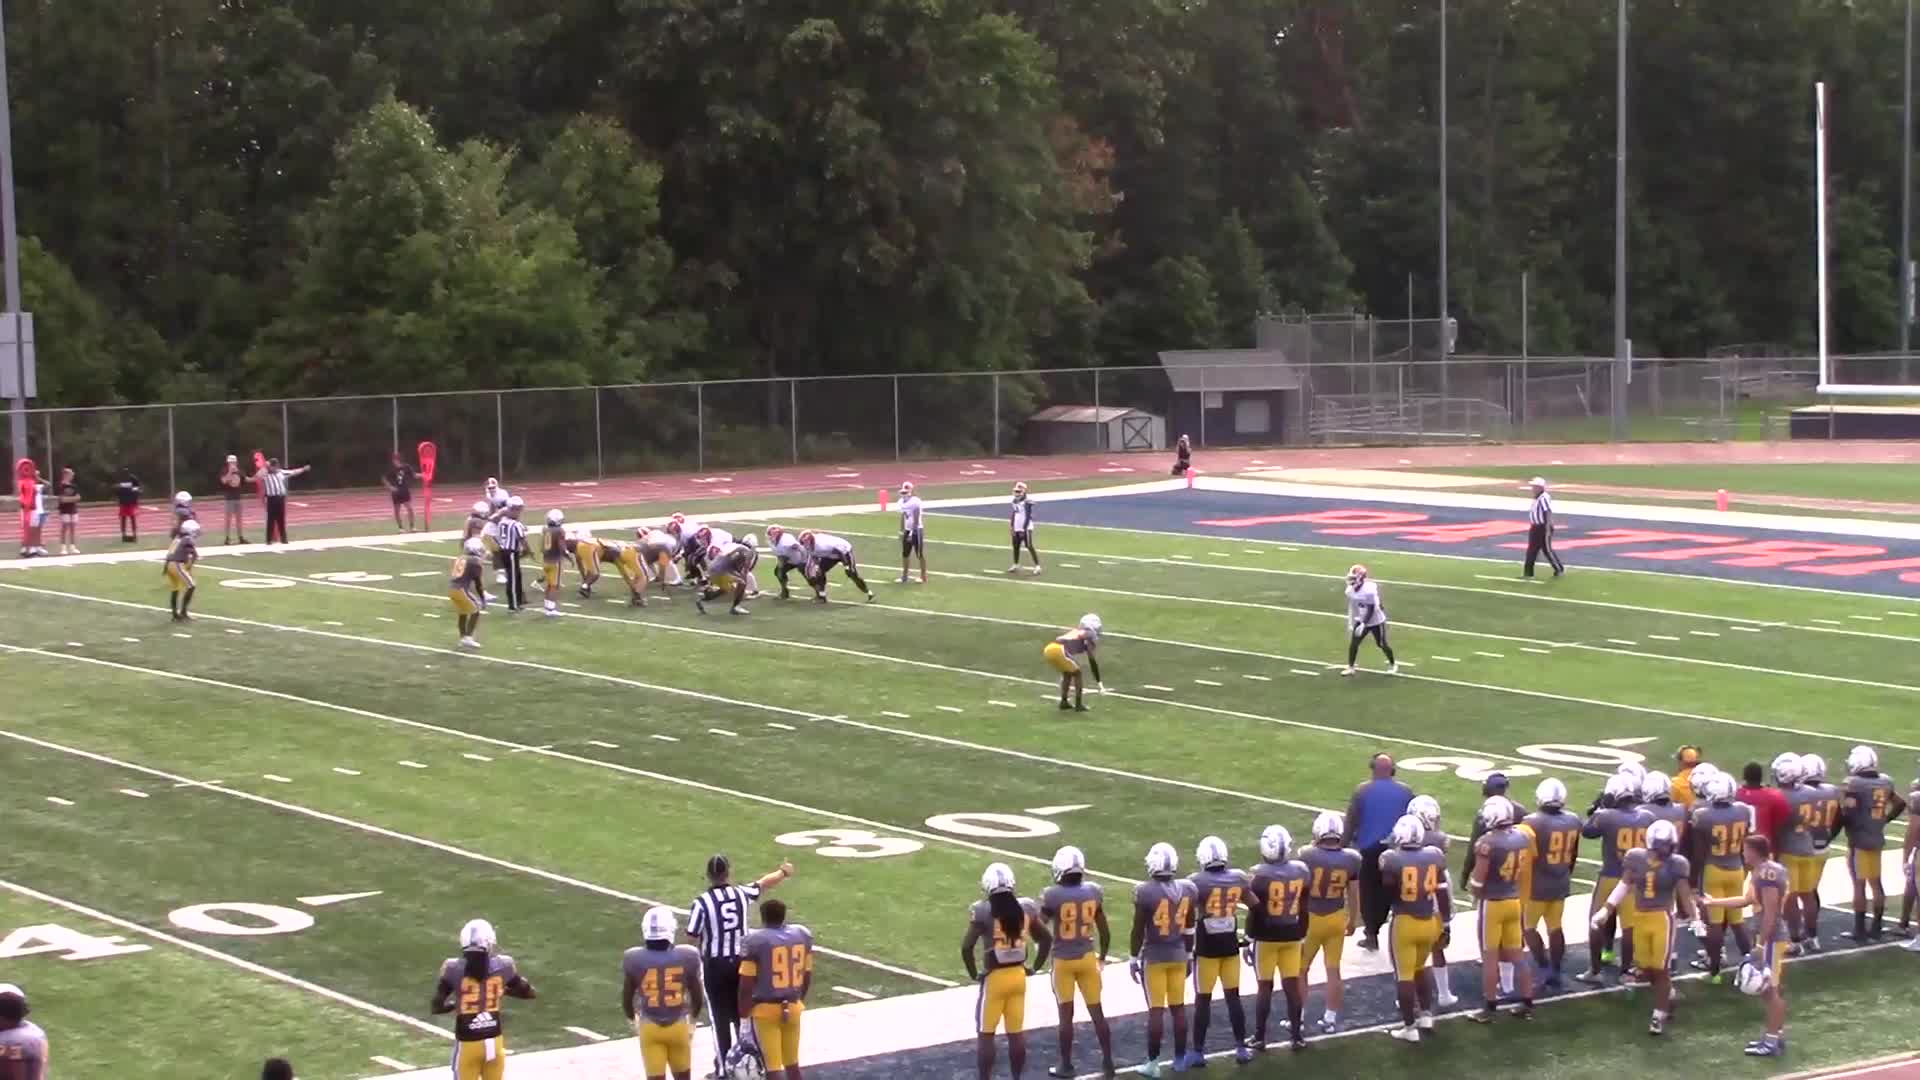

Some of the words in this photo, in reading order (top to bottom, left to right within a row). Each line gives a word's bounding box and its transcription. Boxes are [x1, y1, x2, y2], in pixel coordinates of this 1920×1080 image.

[774, 813, 1060, 857] 30
[1711, 821, 1746, 857] 30
[1267, 878, 1304, 917] 87
[1310, 866, 1348, 899] 12
[1402, 863, 1439, 902] 84
[720, 901, 739, 931] S
[1153, 895, 1190, 937] 44
[772, 944, 806, 989] 92
[640, 967, 684, 1008] 45
